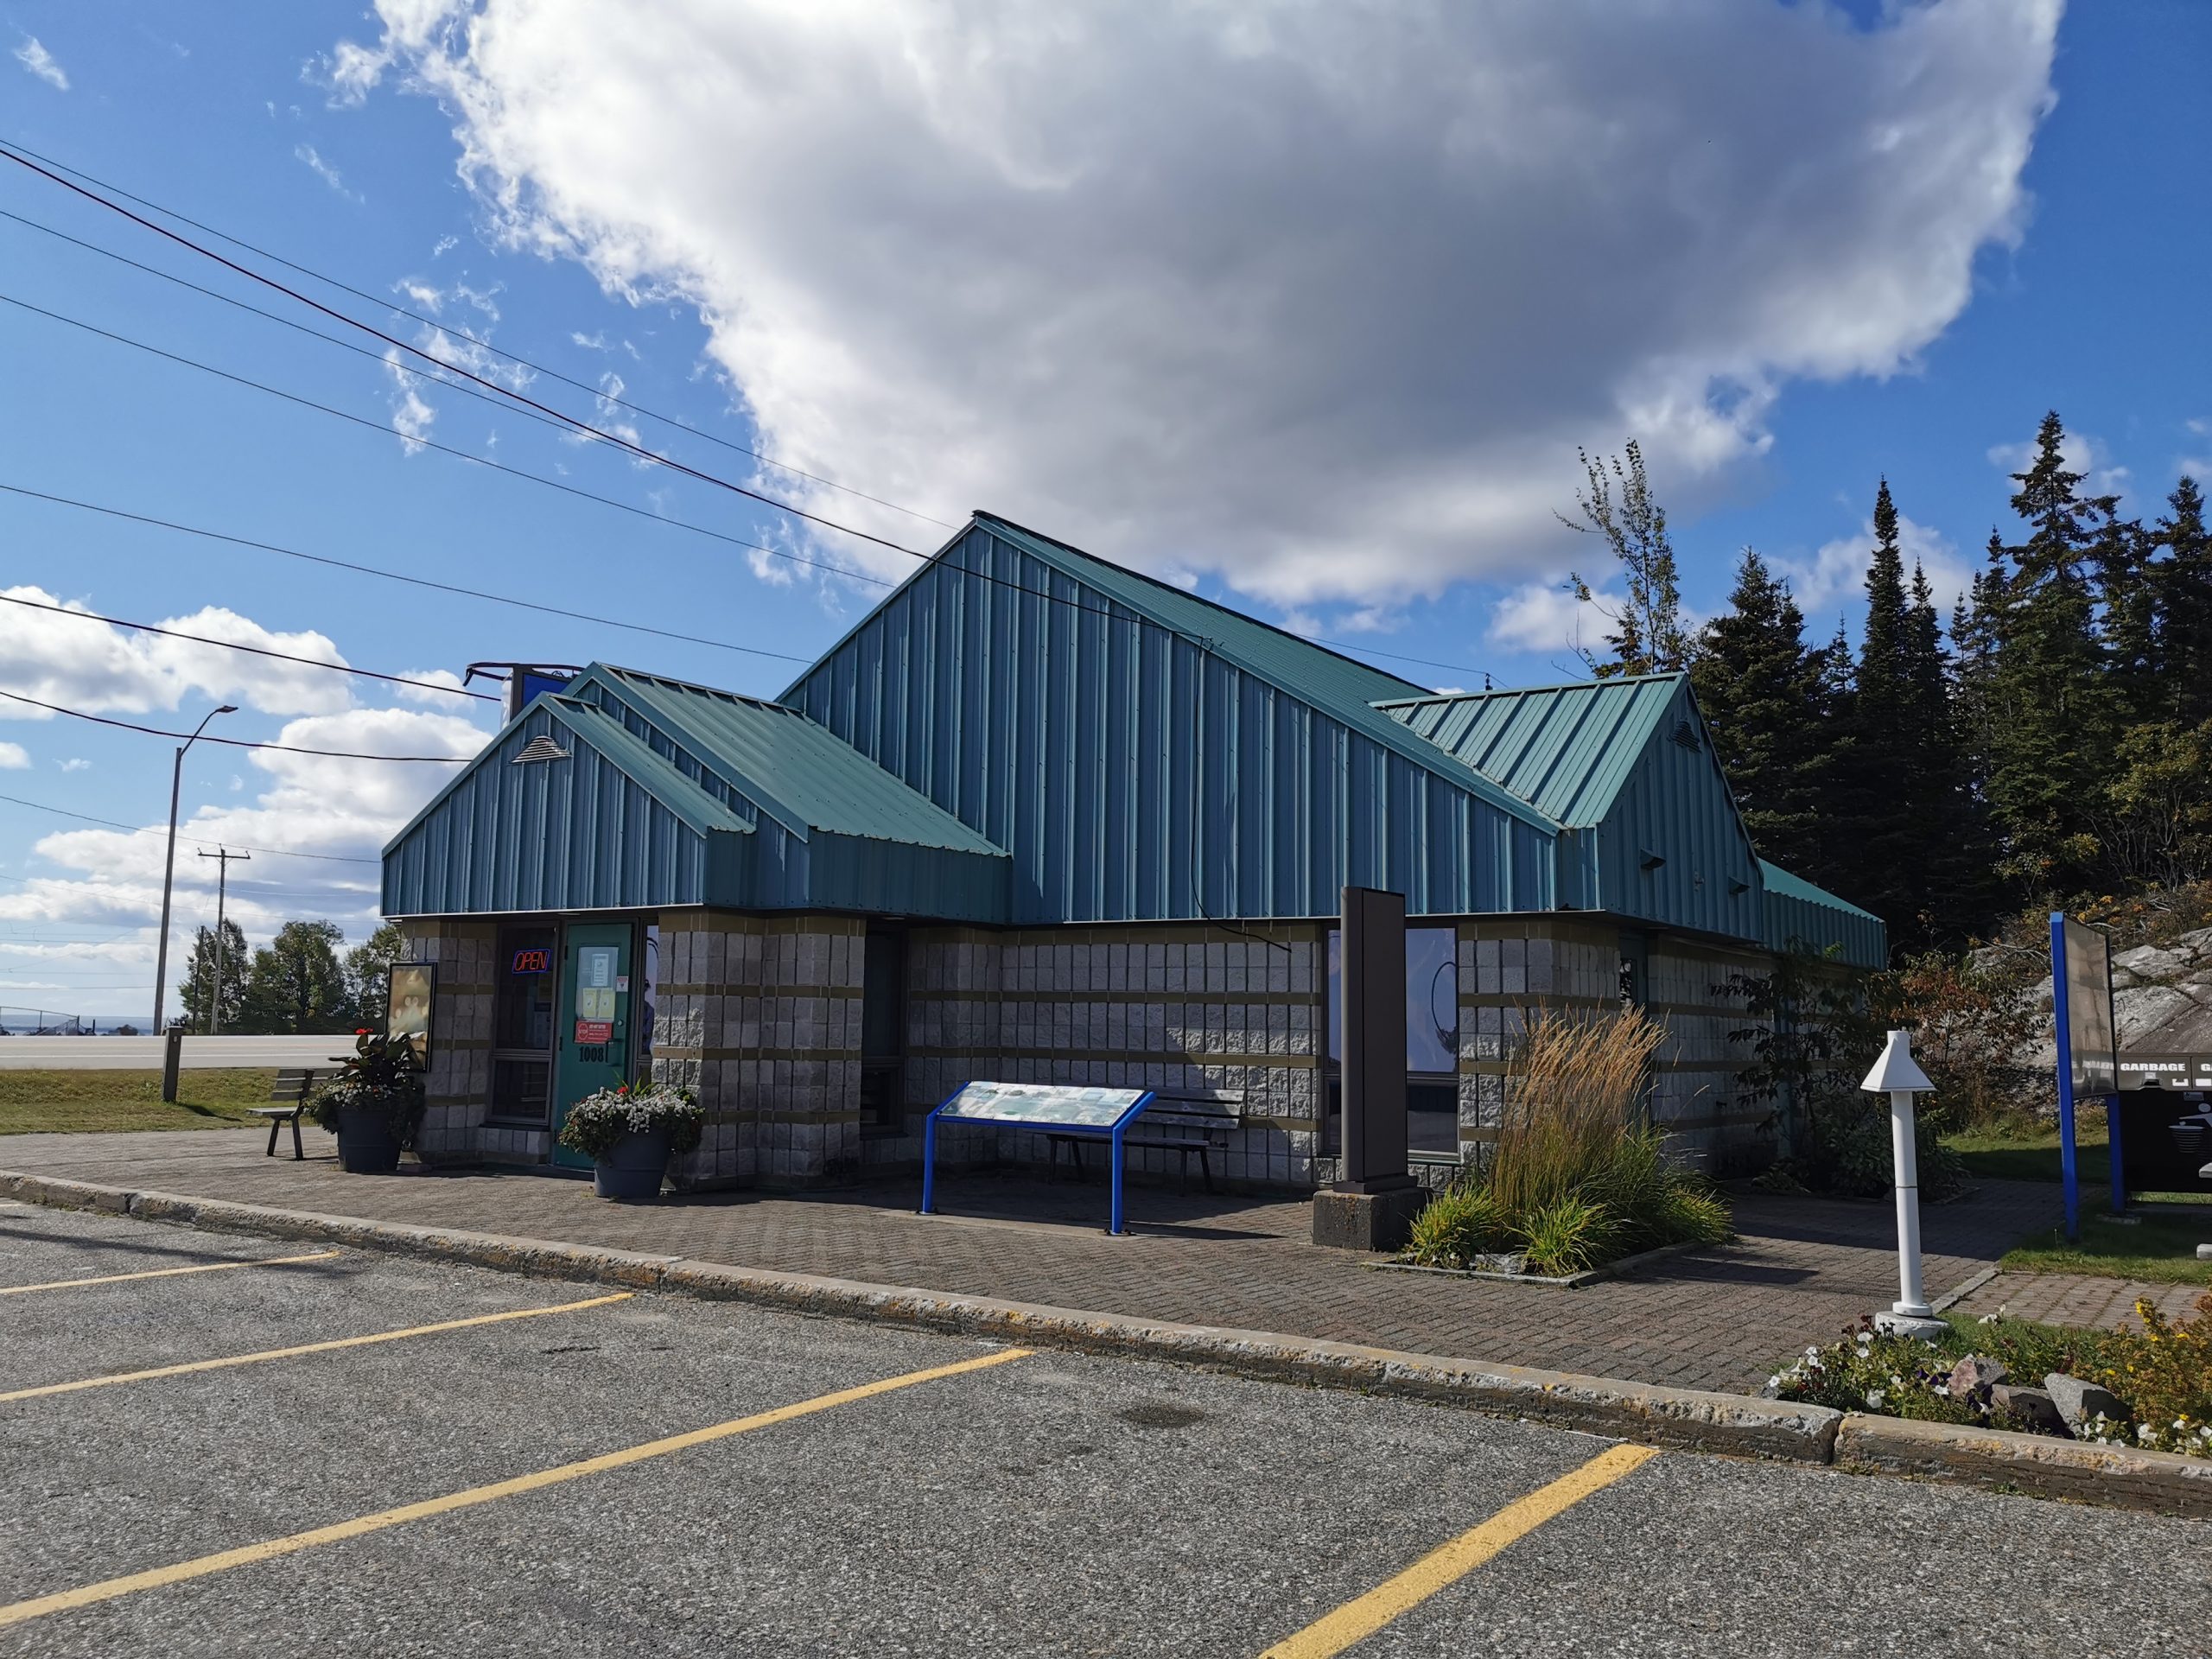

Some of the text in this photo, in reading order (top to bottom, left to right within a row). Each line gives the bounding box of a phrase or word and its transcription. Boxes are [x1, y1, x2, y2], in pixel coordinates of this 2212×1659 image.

[515, 951, 548, 971] OPEN
[579, 1046, 604, 1063] 1008
[2120, 1063, 2186, 1071] GARBAGE
